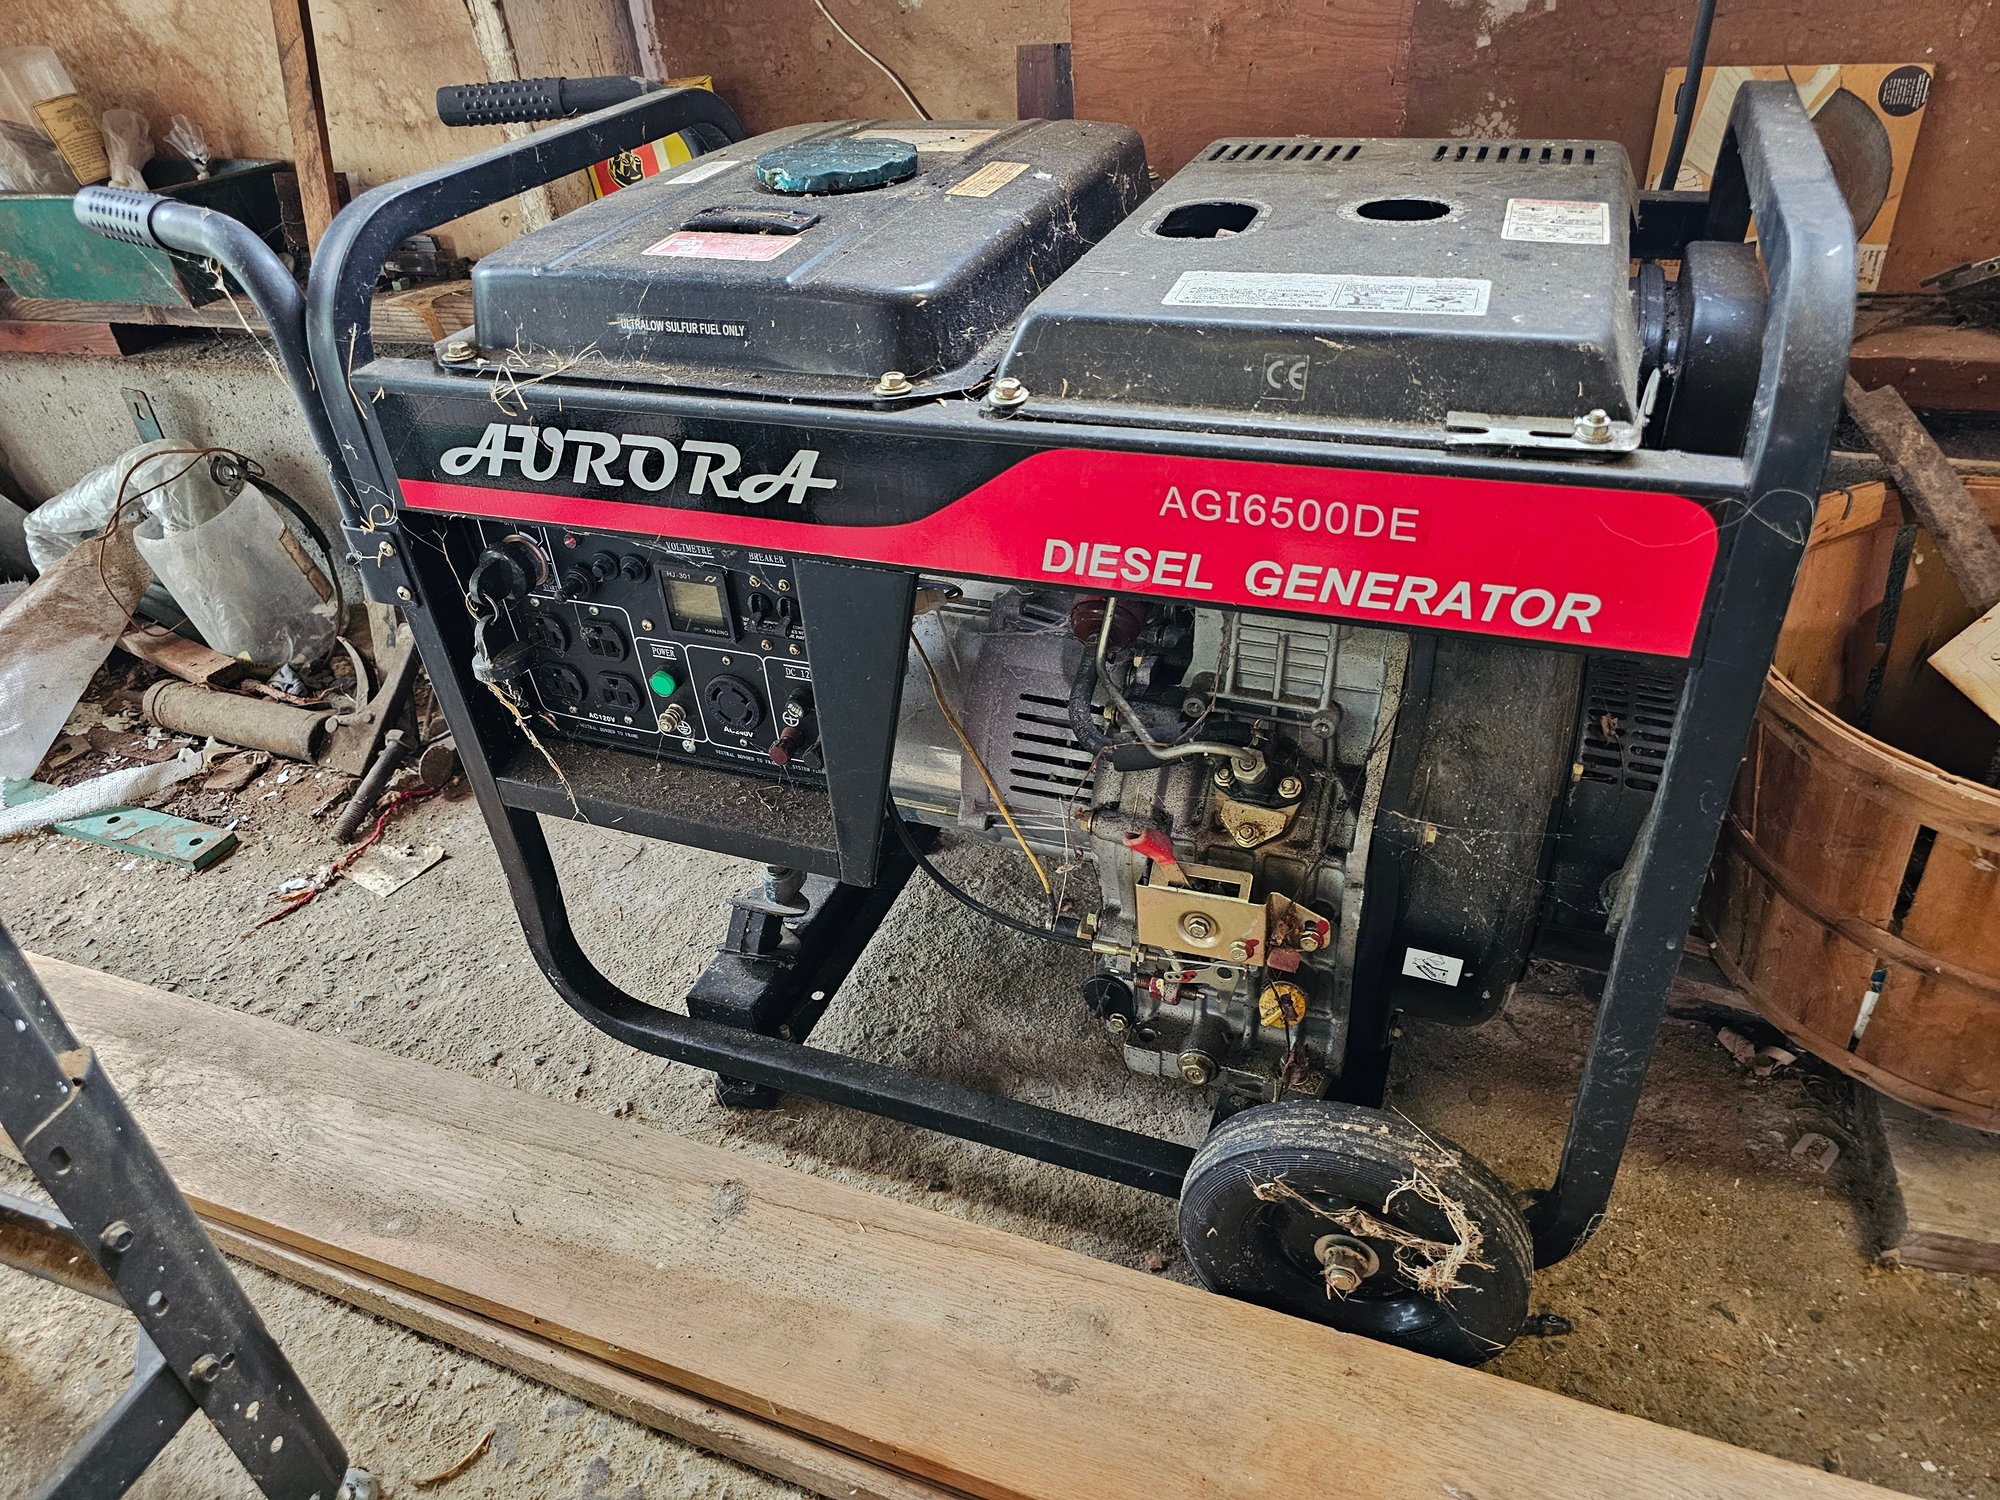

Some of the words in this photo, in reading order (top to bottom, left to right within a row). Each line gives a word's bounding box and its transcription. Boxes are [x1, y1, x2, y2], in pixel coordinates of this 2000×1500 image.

[620, 318, 664, 332] ULTRALOW
[665, 321, 699, 334] SULFUR
[699, 323, 722, 336] FUEL
[722, 325, 745, 337] ONLY
[1266, 360, 1306, 390] CE
[440, 423, 838, 504] AURORA
[1159, 486, 1420, 542] AGI6500DE
[665, 541, 713, 555] VOLTMETRE
[748, 552, 785, 564] BREAKER
[666, 571, 691, 580] HJ-301
[1042, 539, 1213, 590] DIESEL
[1244, 560, 1602, 634] GENERATOR
[651, 646, 675, 657] POWER
[785, 667, 796, 677] DC
[589, 711, 615, 723] AC120V
